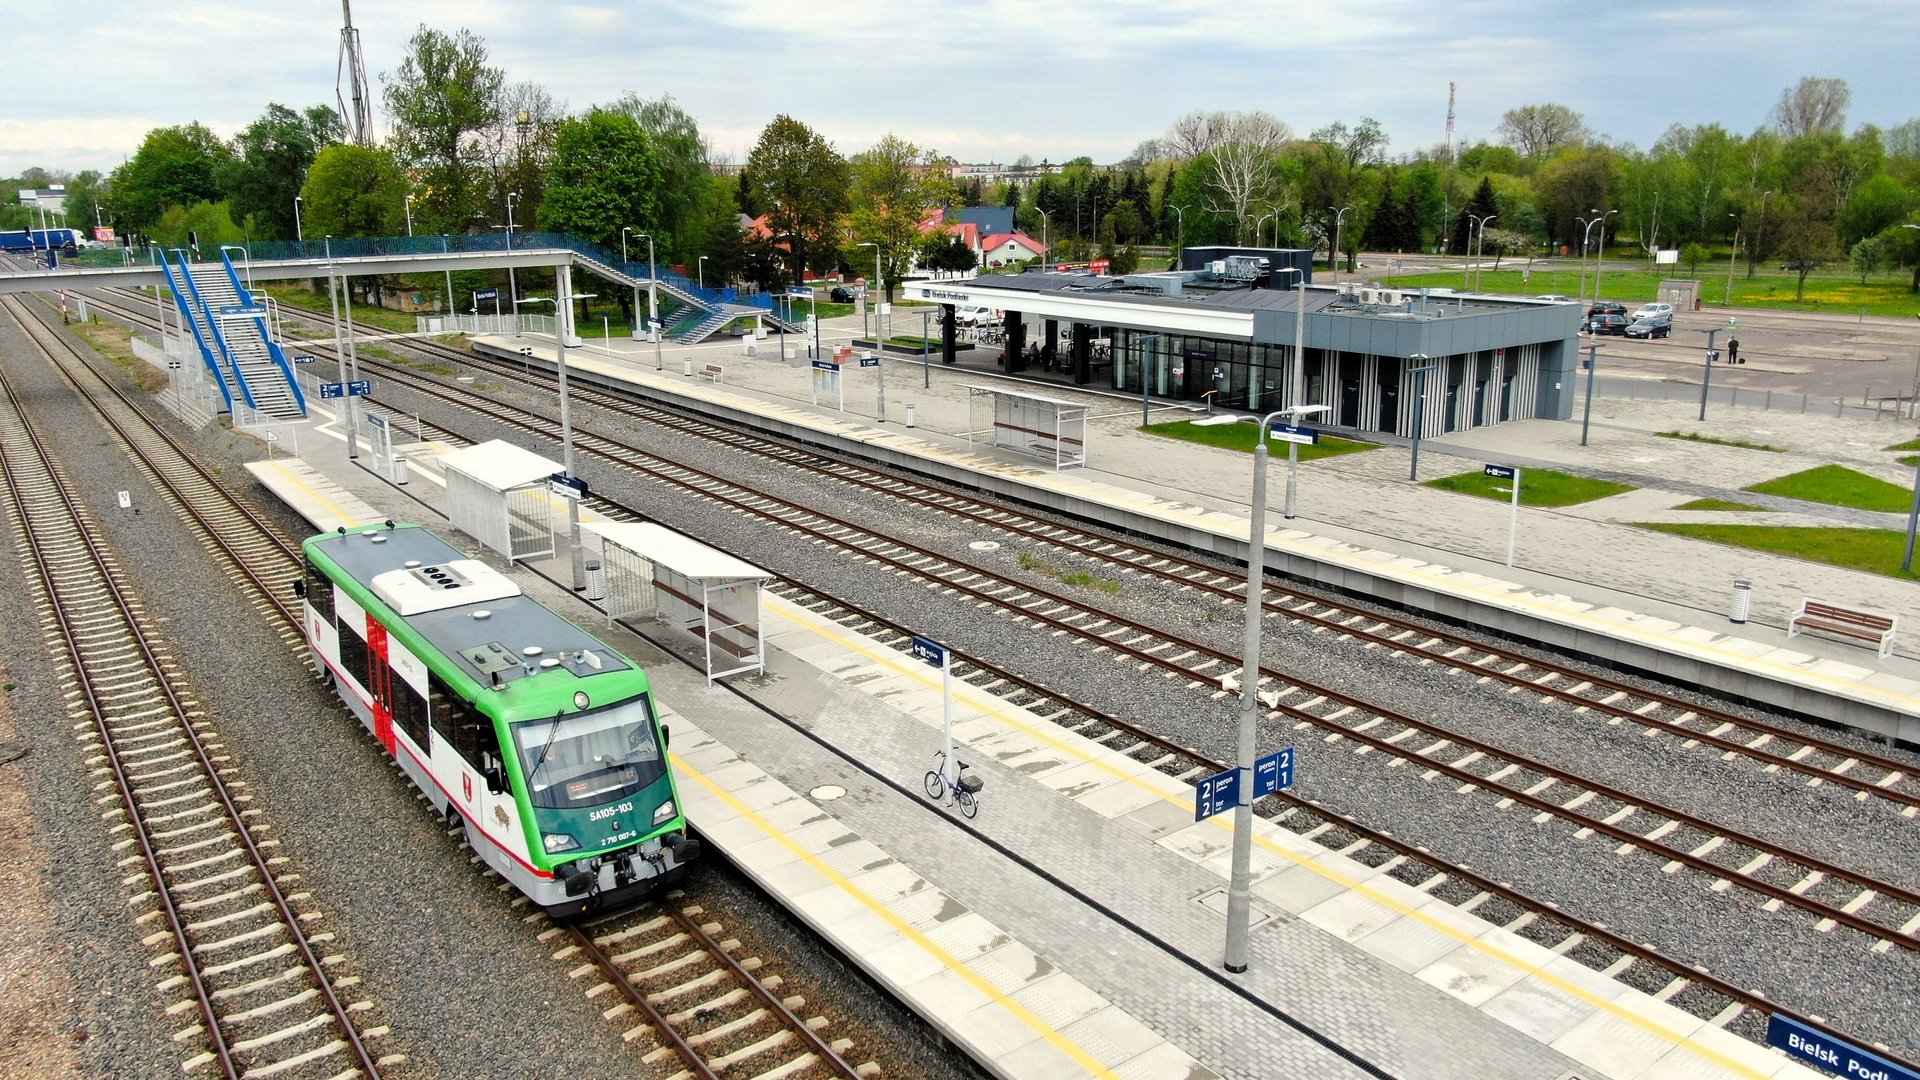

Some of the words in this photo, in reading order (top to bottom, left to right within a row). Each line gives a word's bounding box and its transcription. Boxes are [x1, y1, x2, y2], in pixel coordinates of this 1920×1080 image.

[1258, 760, 1276, 773] peron
[1280, 752, 1289, 769] 2
[1202, 782, 1211, 799] 2
[1216, 776, 1234, 788] peron
[1266, 779, 1275, 788] tor
[1281, 771, 1287, 785] 1
[589, 802, 634, 821] SA105-103
[1202, 802, 1210, 816] 2
[1788, 1033, 1839, 1066] Bielsk
